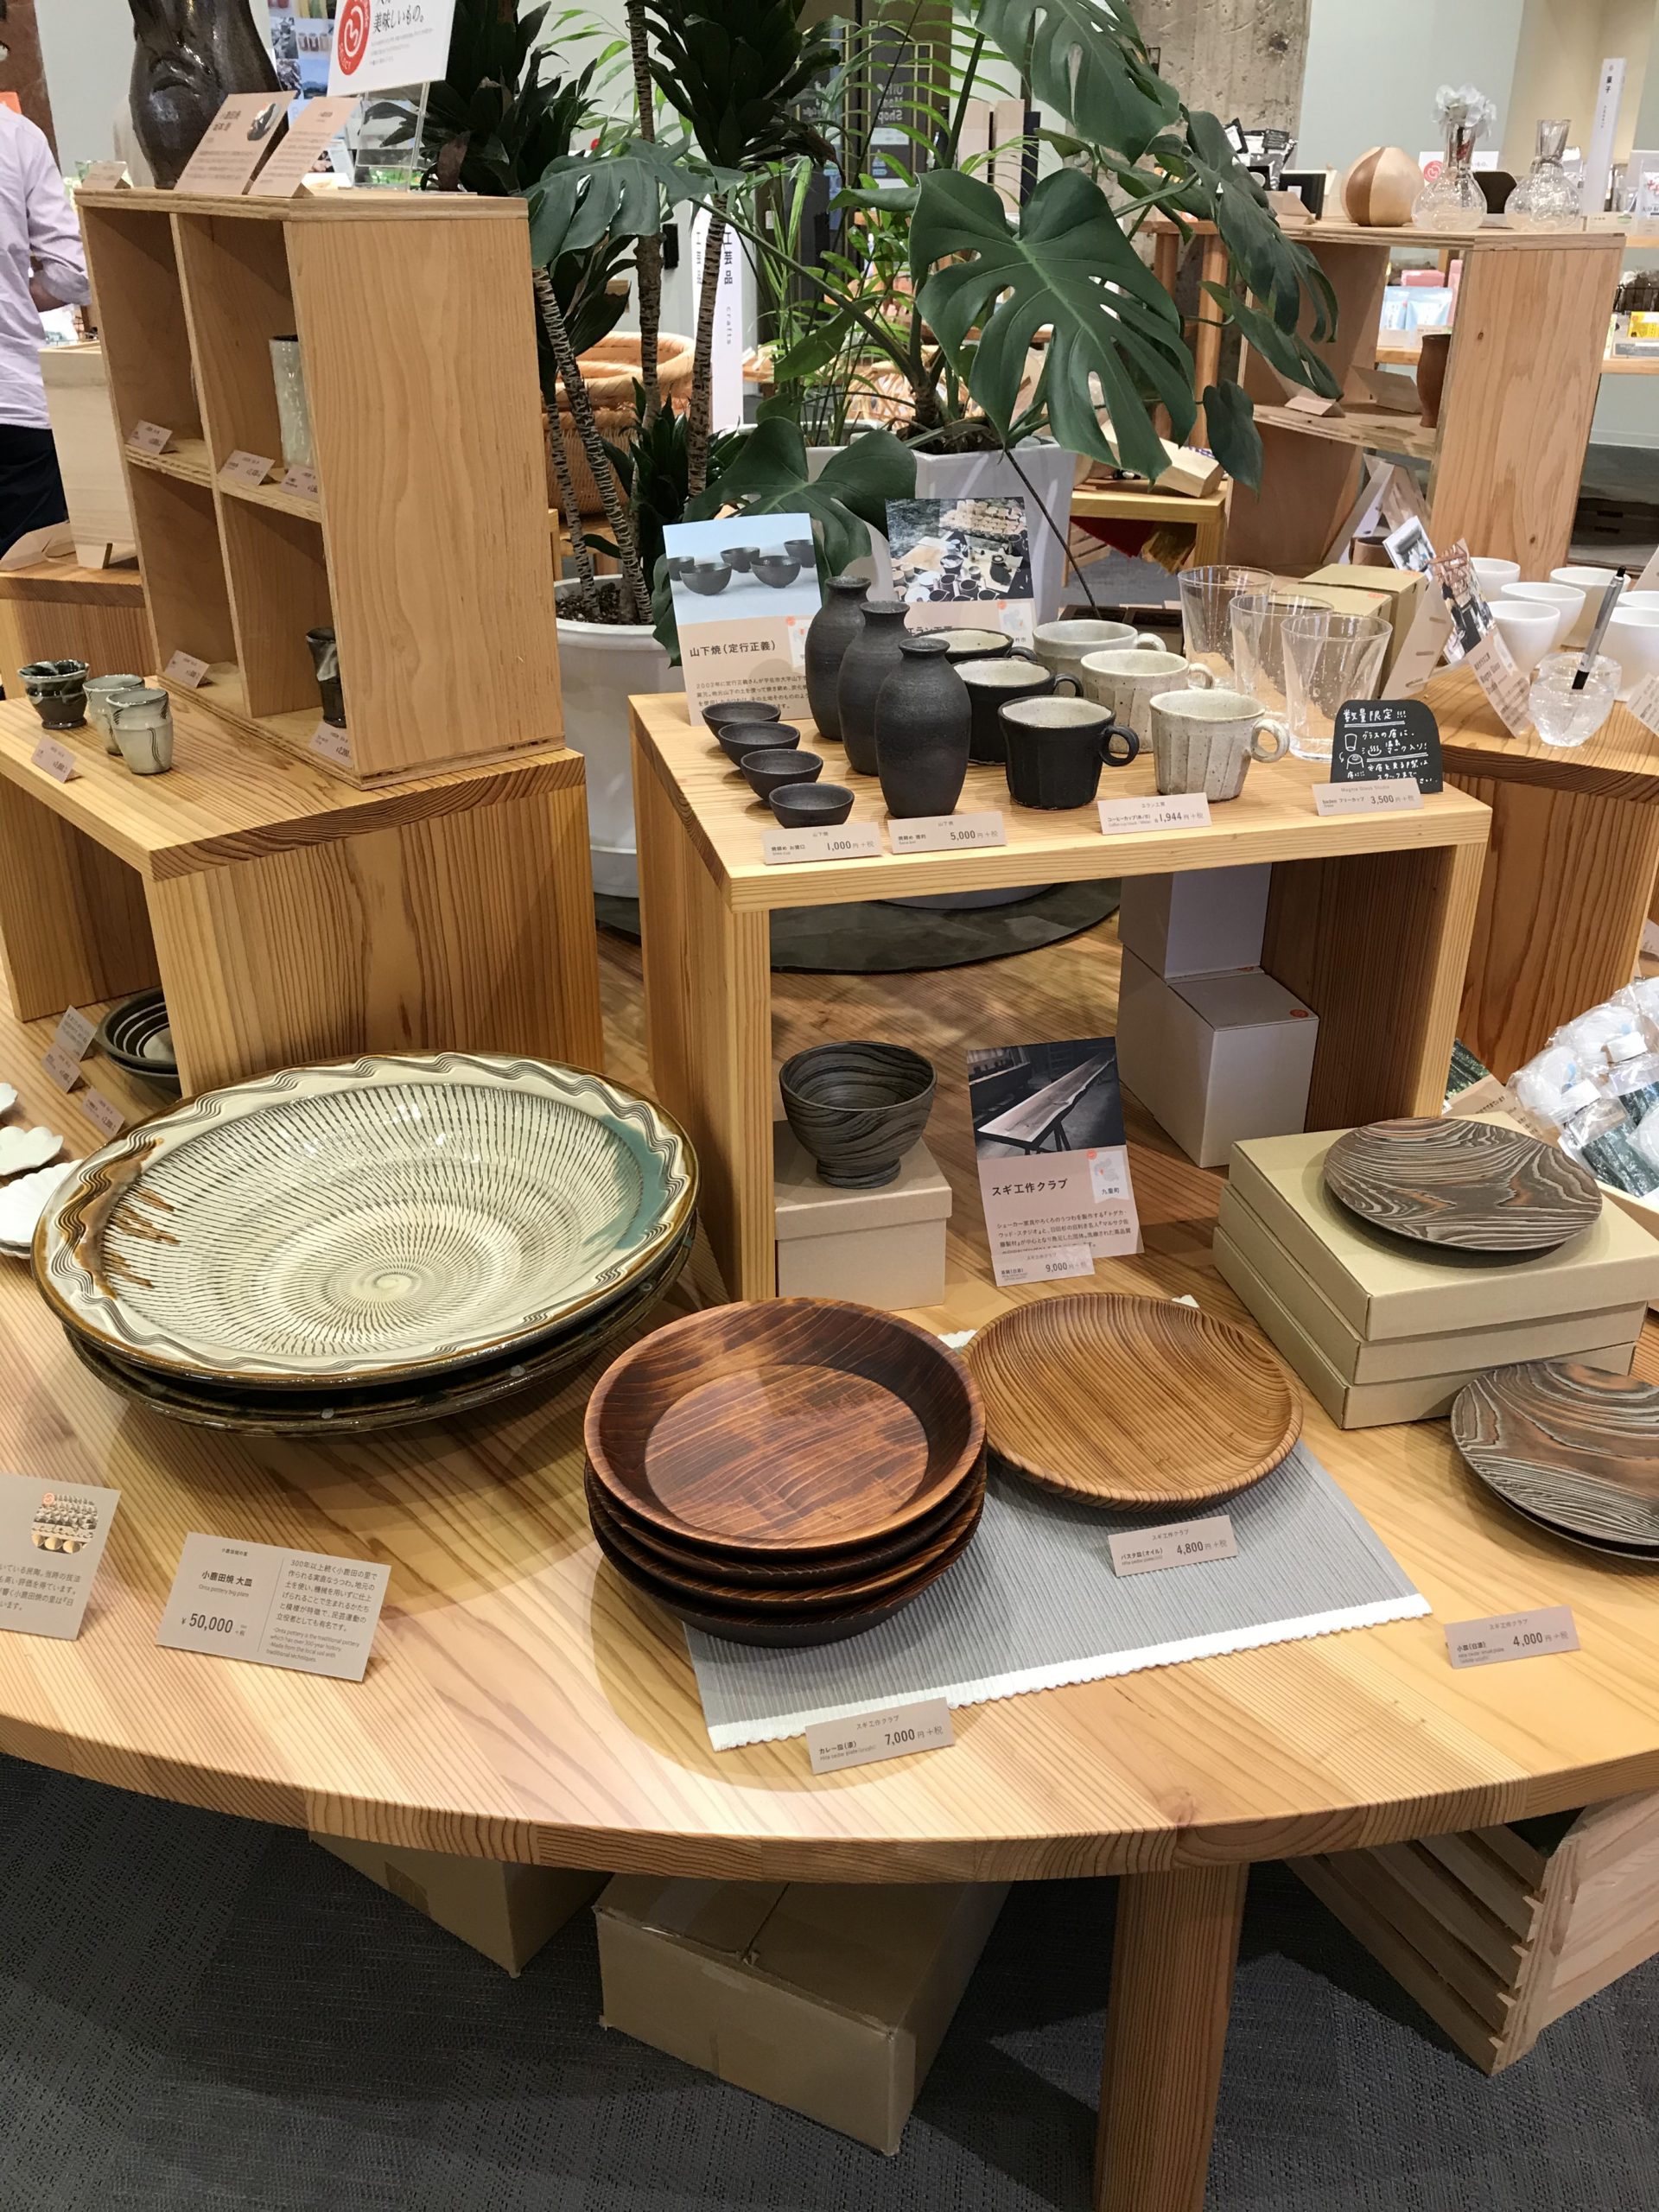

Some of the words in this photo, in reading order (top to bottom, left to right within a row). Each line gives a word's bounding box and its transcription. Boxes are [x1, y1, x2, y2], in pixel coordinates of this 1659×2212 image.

[373, 5, 423, 34] 美味しいもの。
[724, 232, 734, 285] 工芸品
[690, 640, 776, 657] 山下焼(定行正義)
[992, 1178, 1068, 1197] スギ工作クラブ
[1153, 1529, 1189, 1540] スギ工作クラブ
[856, 1714, 899, 1730] スギ工作クラブ
